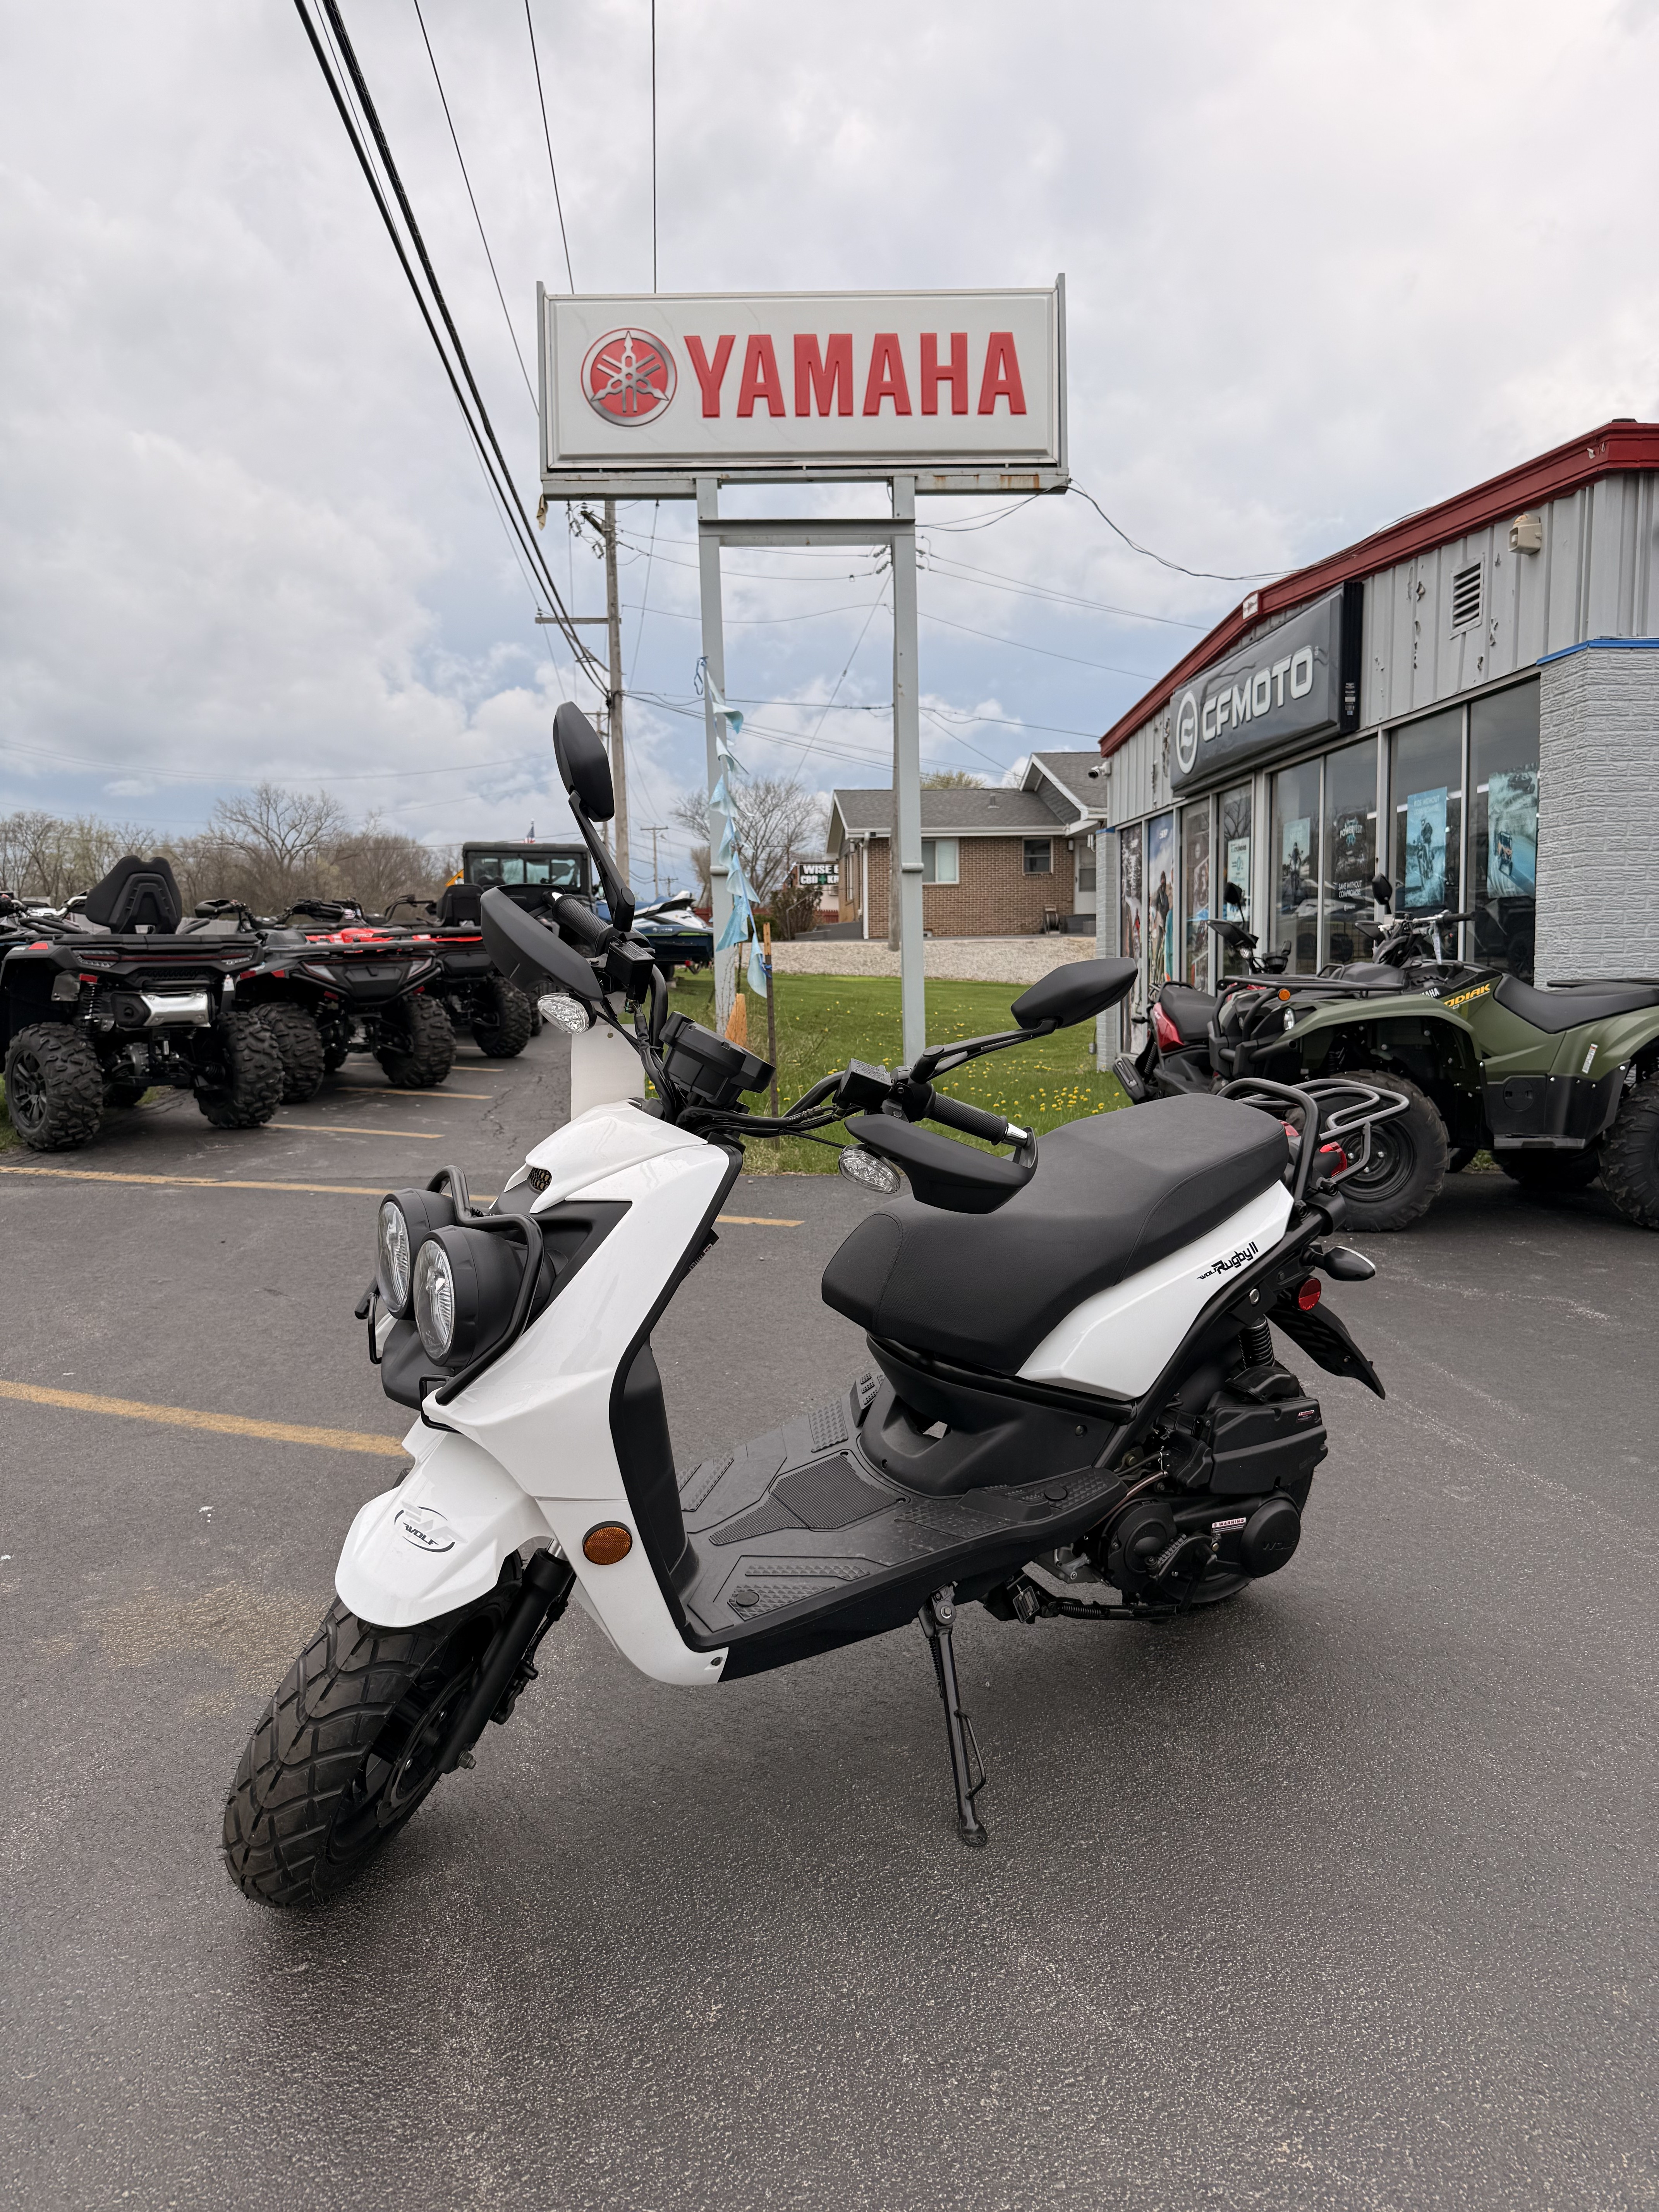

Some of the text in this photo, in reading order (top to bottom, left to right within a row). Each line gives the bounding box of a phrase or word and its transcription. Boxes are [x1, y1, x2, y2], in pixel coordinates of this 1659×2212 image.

[684, 332, 1027, 418] YAMAHA
[1202, 645, 1313, 743] CFMOTO
[800, 876, 818, 884] CBD
[803, 865, 832, 874] WISE
[1444, 983, 1490, 1007] ODIAK
[1211, 1248, 1254, 1274] Rugby
[403, 1522, 439, 1545] WOLF
